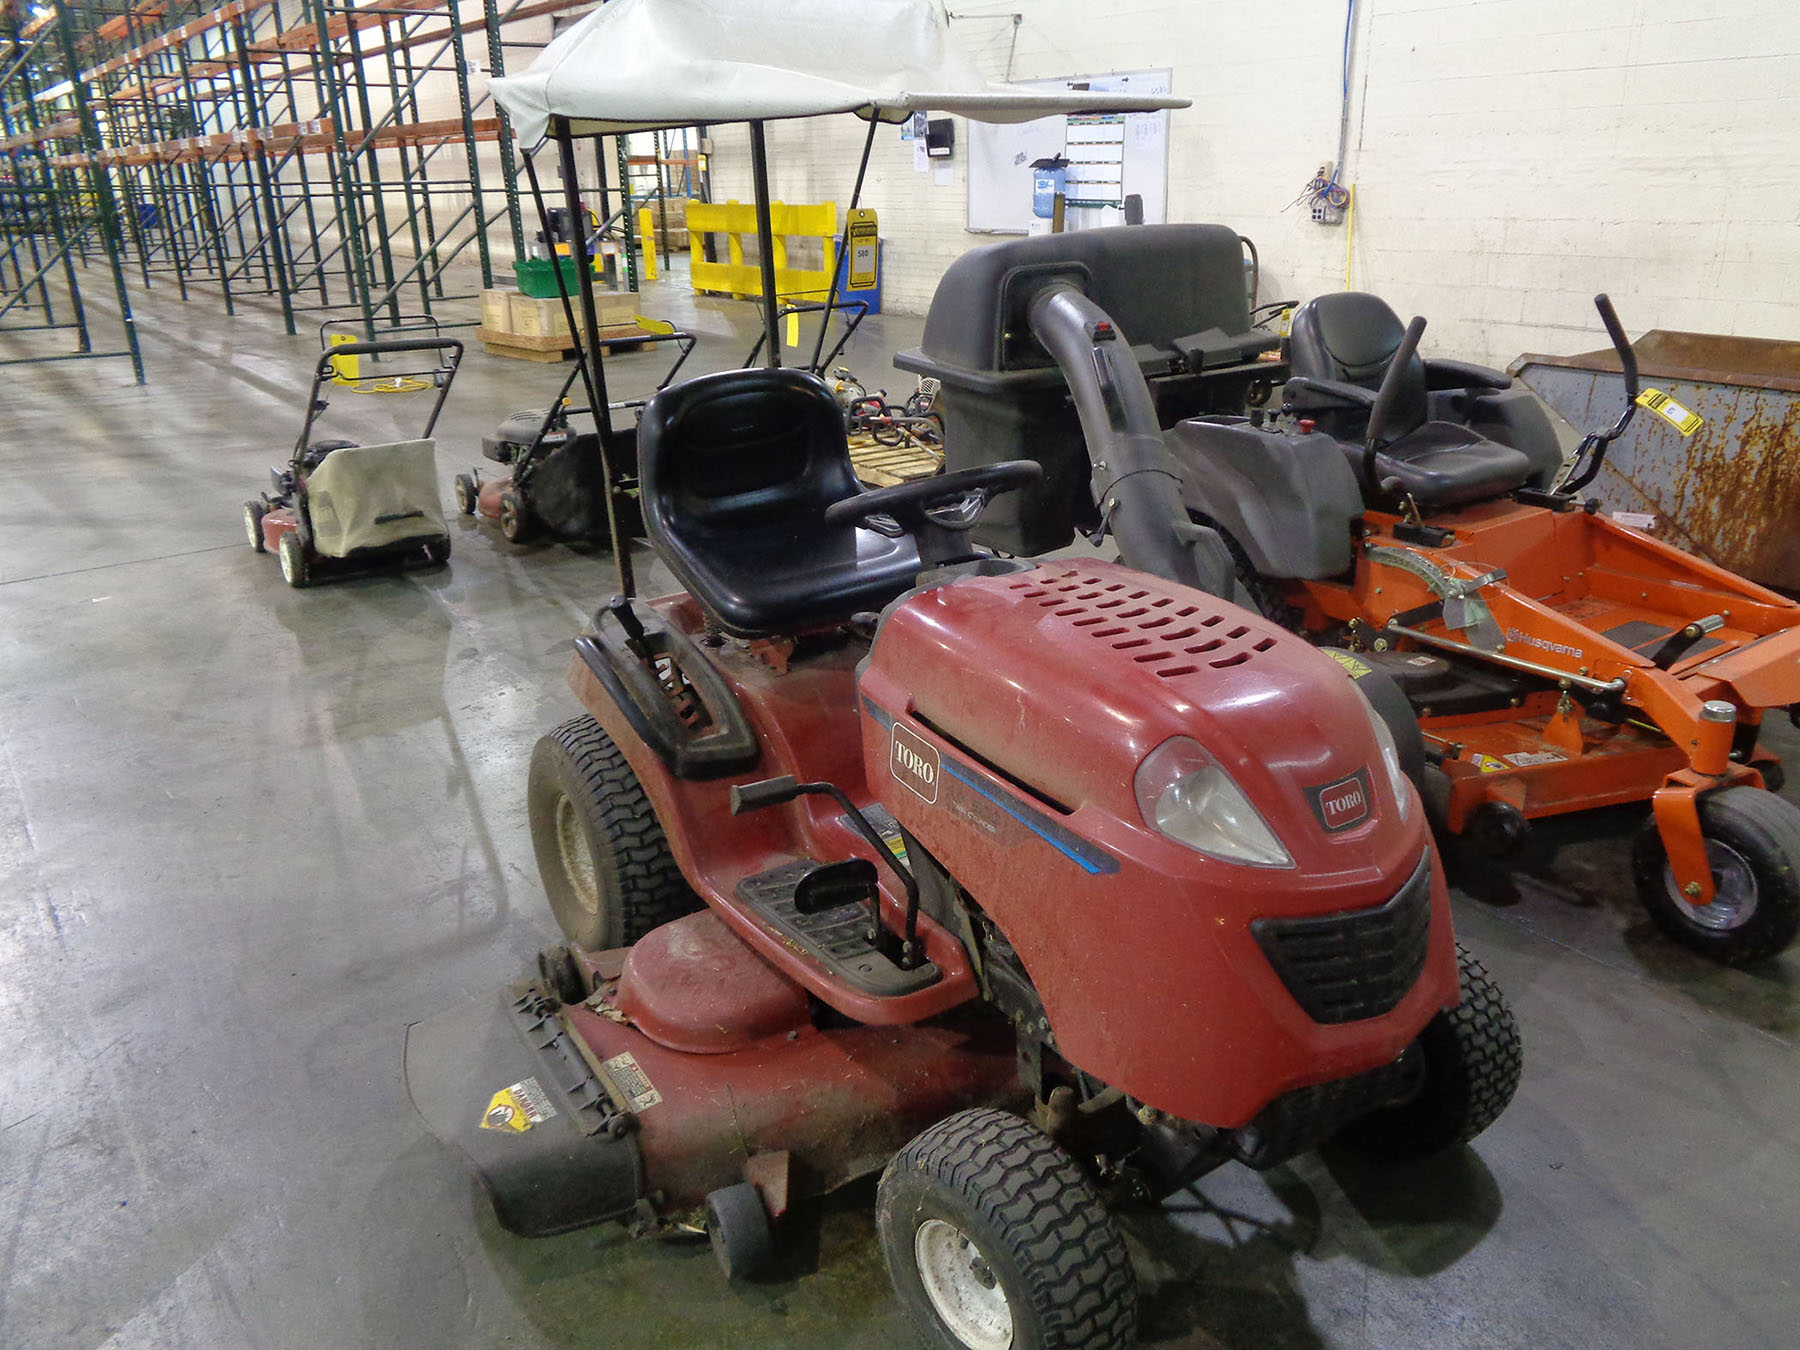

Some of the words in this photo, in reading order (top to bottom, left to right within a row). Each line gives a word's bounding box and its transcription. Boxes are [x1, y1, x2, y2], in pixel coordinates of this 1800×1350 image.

[1518, 631, 1583, 659] Husqvarna
[895, 740, 935, 784] TORO
[1325, 790, 1361, 816] TORO
